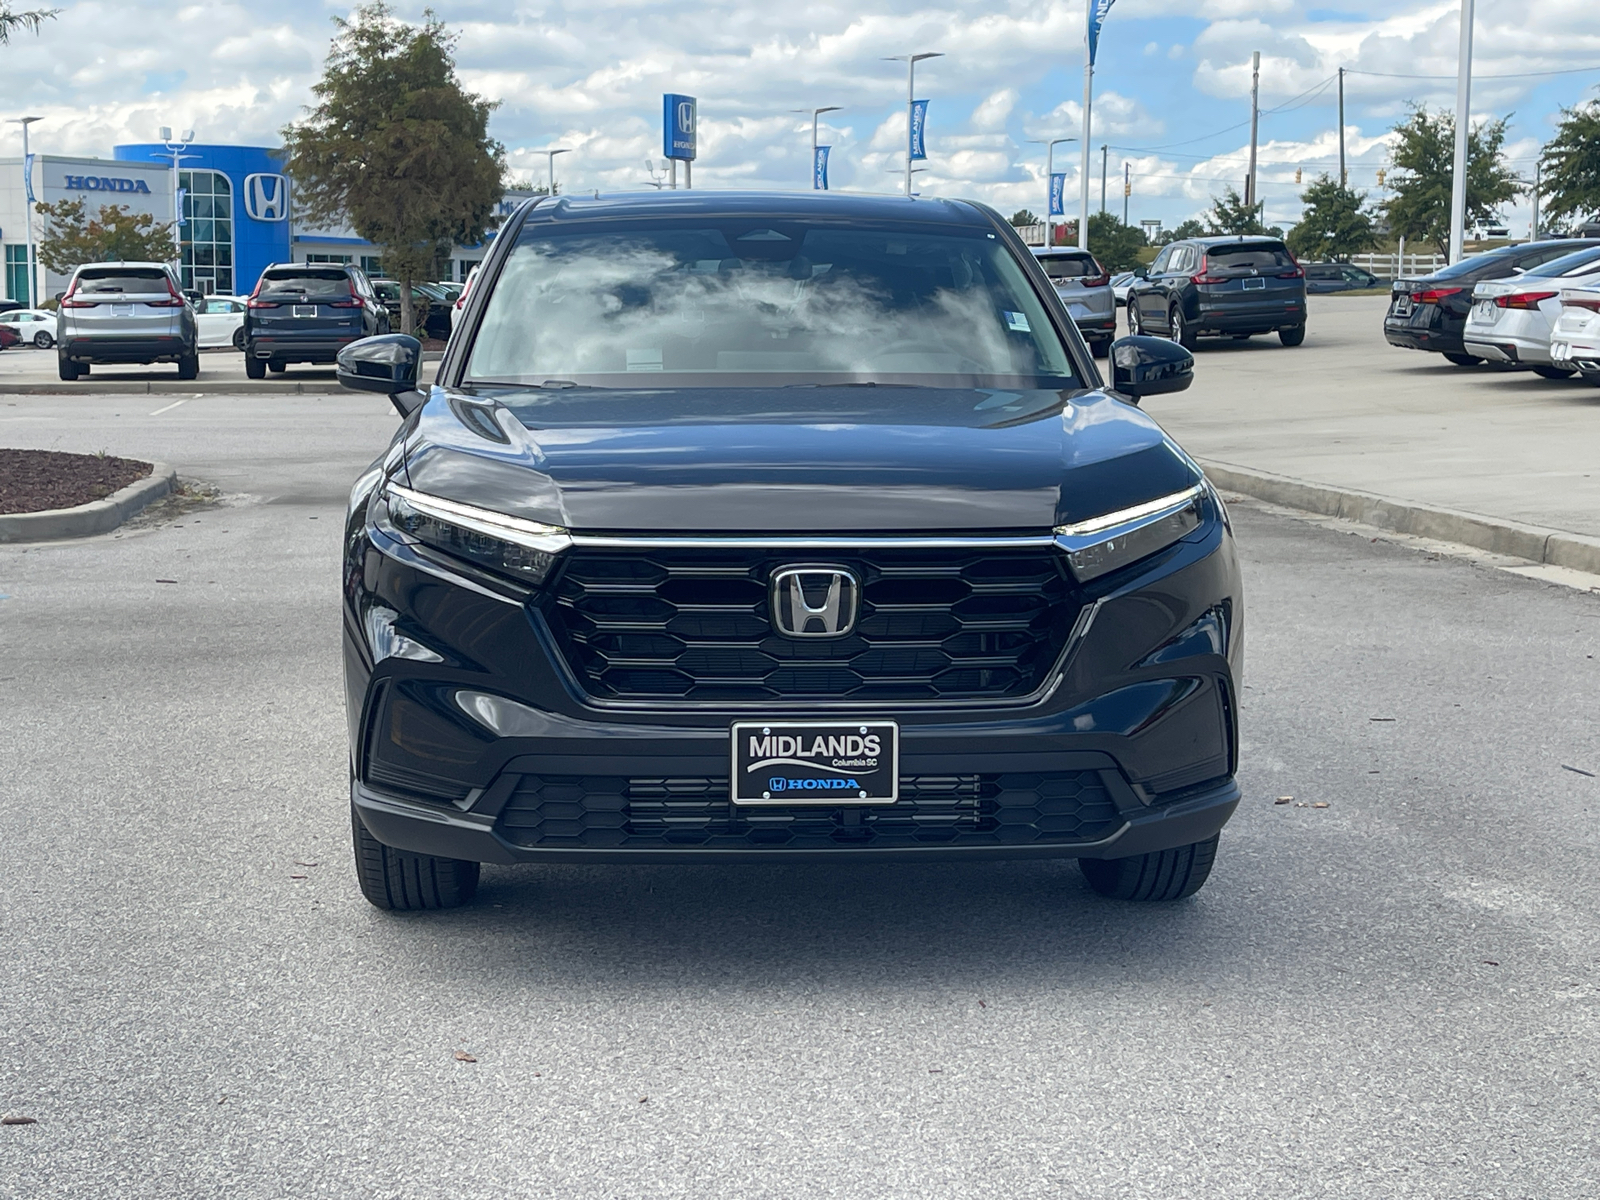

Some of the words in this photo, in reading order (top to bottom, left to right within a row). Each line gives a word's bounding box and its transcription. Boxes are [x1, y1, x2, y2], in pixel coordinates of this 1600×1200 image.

[912, 105, 922, 154] MIDLANDS
[65, 175, 151, 194] HONDA
[749, 735, 881, 757] MIDLANDS
[832, 758, 866, 767] Columbia
[866, 758, 877, 767] SC
[788, 779, 861, 789] HONDA
